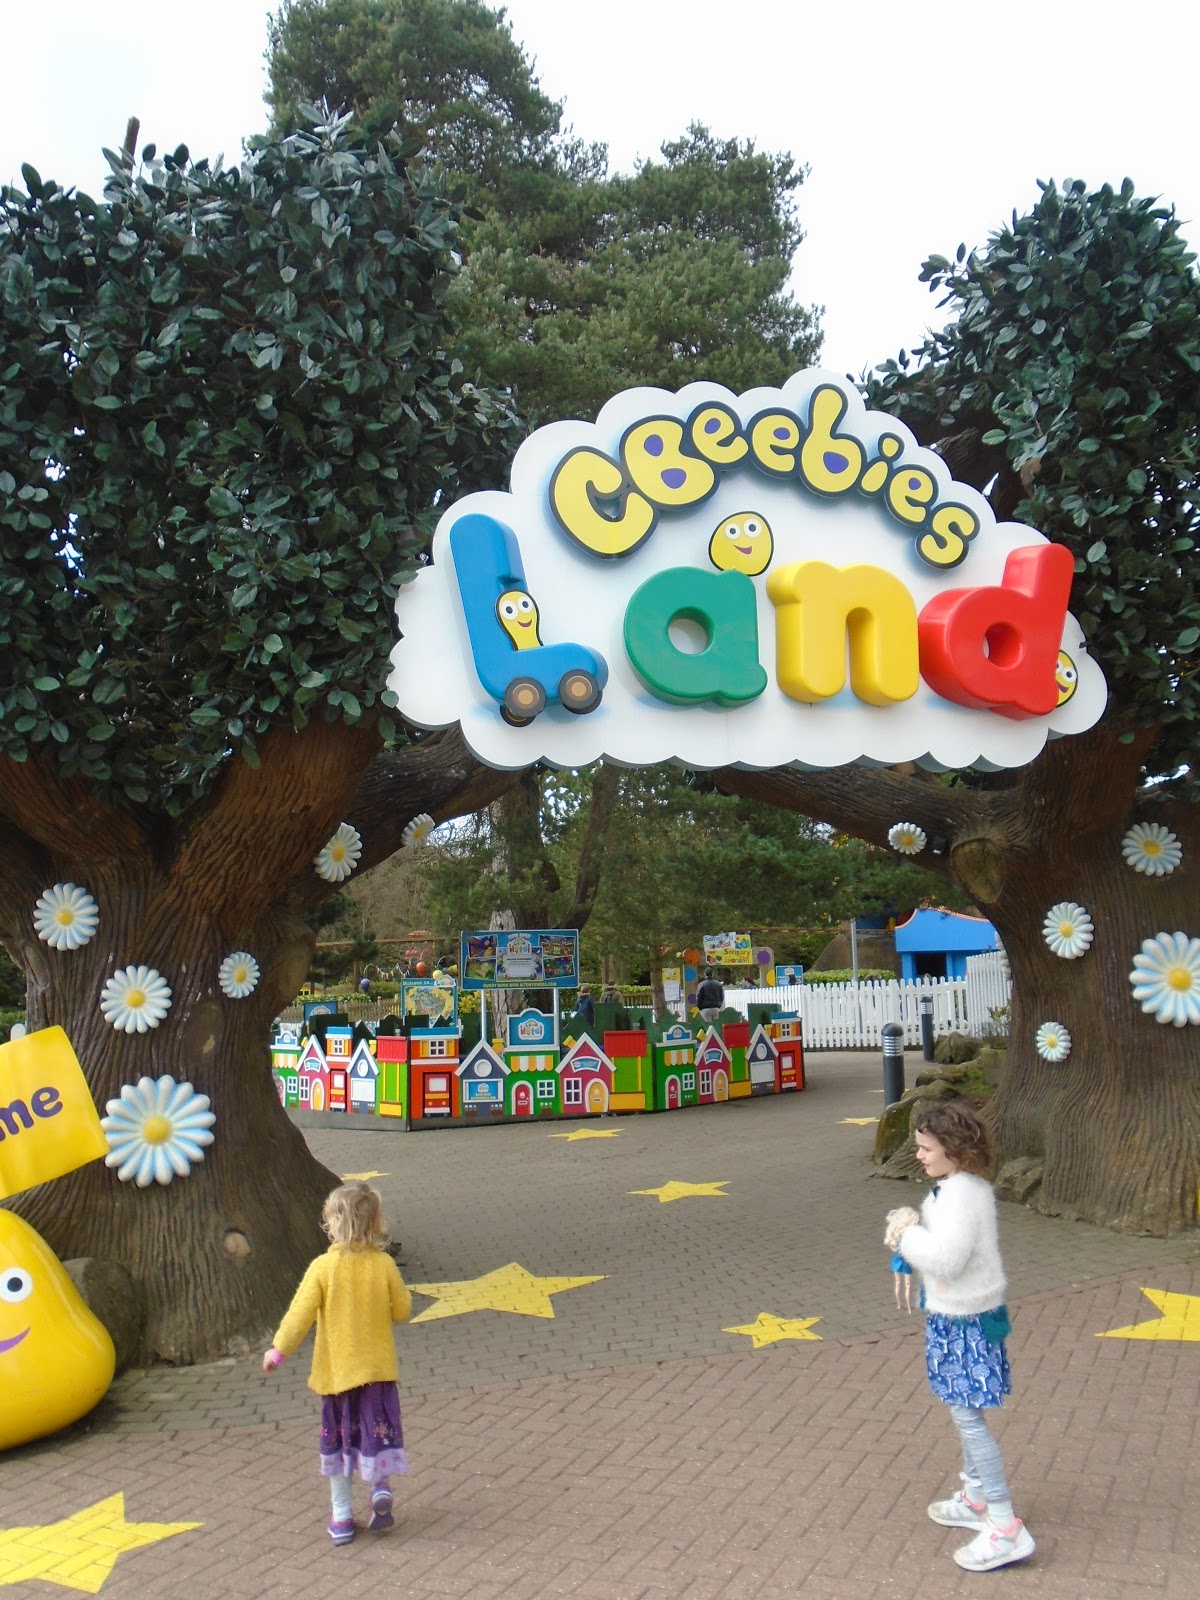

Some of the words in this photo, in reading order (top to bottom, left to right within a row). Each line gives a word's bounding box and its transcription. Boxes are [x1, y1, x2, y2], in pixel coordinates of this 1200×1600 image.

[549, 383, 980, 569] CBeebies
[449, 513, 1076, 722] Land
[724, 948, 751, 958] Sensory
[520, 1025, 543, 1036] Hotel
